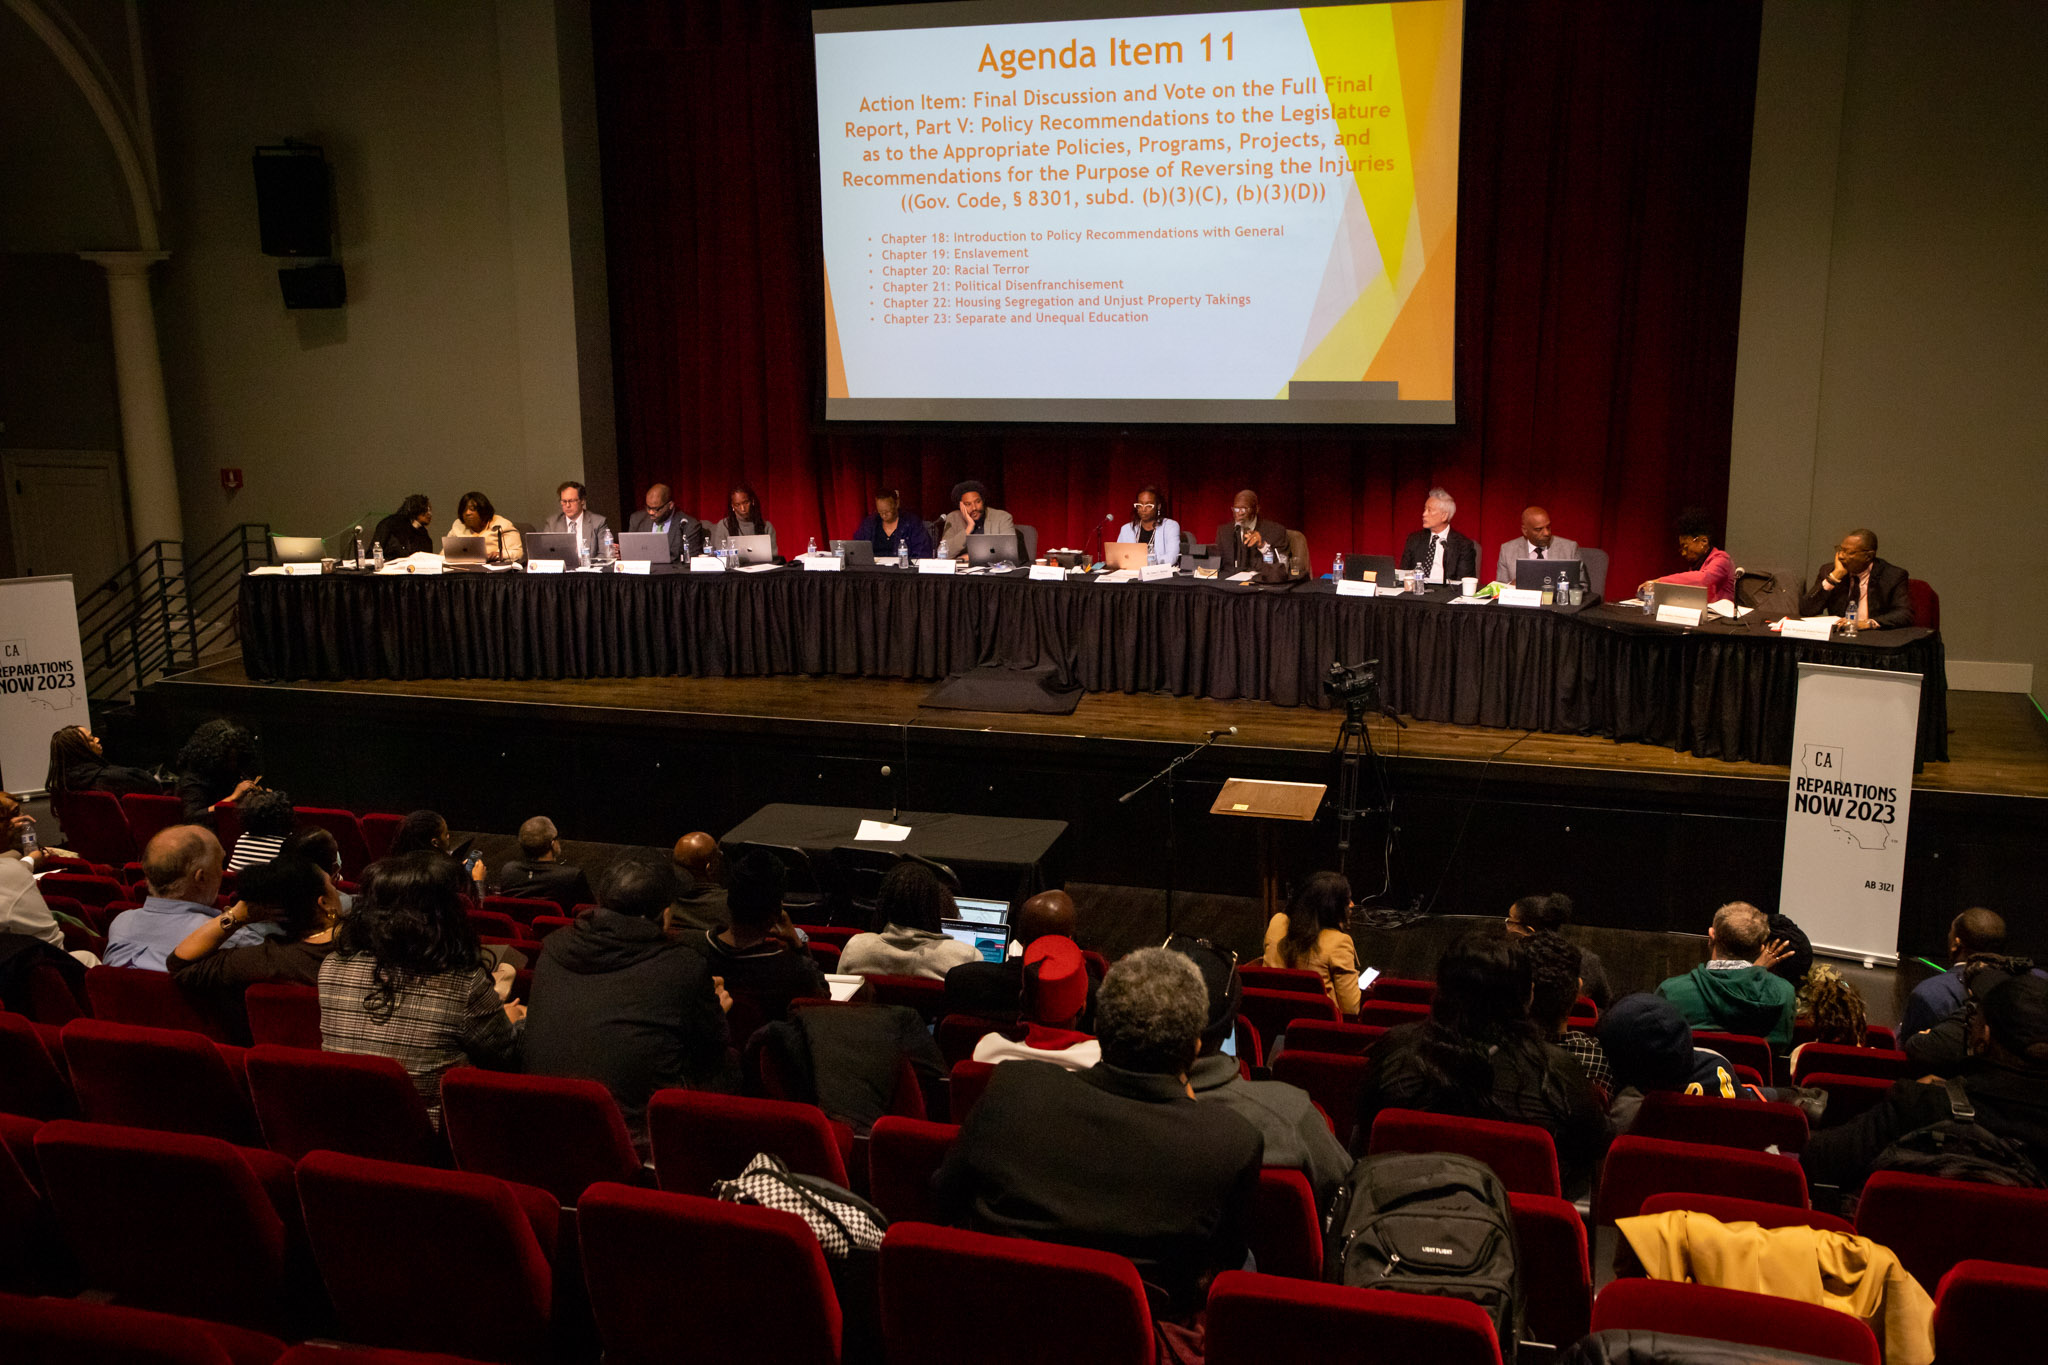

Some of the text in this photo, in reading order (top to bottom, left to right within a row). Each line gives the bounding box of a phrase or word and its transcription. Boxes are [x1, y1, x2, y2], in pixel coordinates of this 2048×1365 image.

[978, 32, 1233, 79] Agenda Item 11
[859, 74, 1372, 112] Action Item: Final Discussion and Vote on the Full Final
[845, 103, 1391, 141] Report, Part V: Policy Recommendations to the Legislature
[863, 128, 1370, 163] as to the Appropriate Policies, Programs, Projects, and
[843, 154, 1394, 187] Recommendations for the Purpose of Reversing the Injuries
[902, 194, 949, 213] ((Gov.
[957, 192, 1006, 211] Code,
[1028, 190, 1079, 208] 8301,
[1086, 187, 1134, 205] subd.
[1143, 185, 1228, 207] (b)(3)(C),
[1237, 182, 1326, 205] (b)(3)(D))
[882, 225, 1284, 246] Chapter 18: Introduction to Policy Recommendations with General
[882, 248, 1029, 263] Chapter 19: Enslavement
[883, 264, 1029, 278] Chapter 20: Racial Terror
[883, 279, 1124, 295] Chapter 21: Political Disenfranchisement
[884, 293, 1251, 310] Chapter 22: Housing Segregation and Unjust Property Takings
[884, 311, 1148, 327] Chapter 23: Separate and Unequal Education
[5, 645, 20, 657] CA
[0, 660, 74, 678] EPARATIONS
[37, 673, 76, 691] 2023
[1815, 752, 1832, 768] CA
[1796, 776, 1897, 803] REPARATIONS
[1794, 793, 1895, 824] NOW 2023
[1864, 880, 1895, 892] AB 3121
